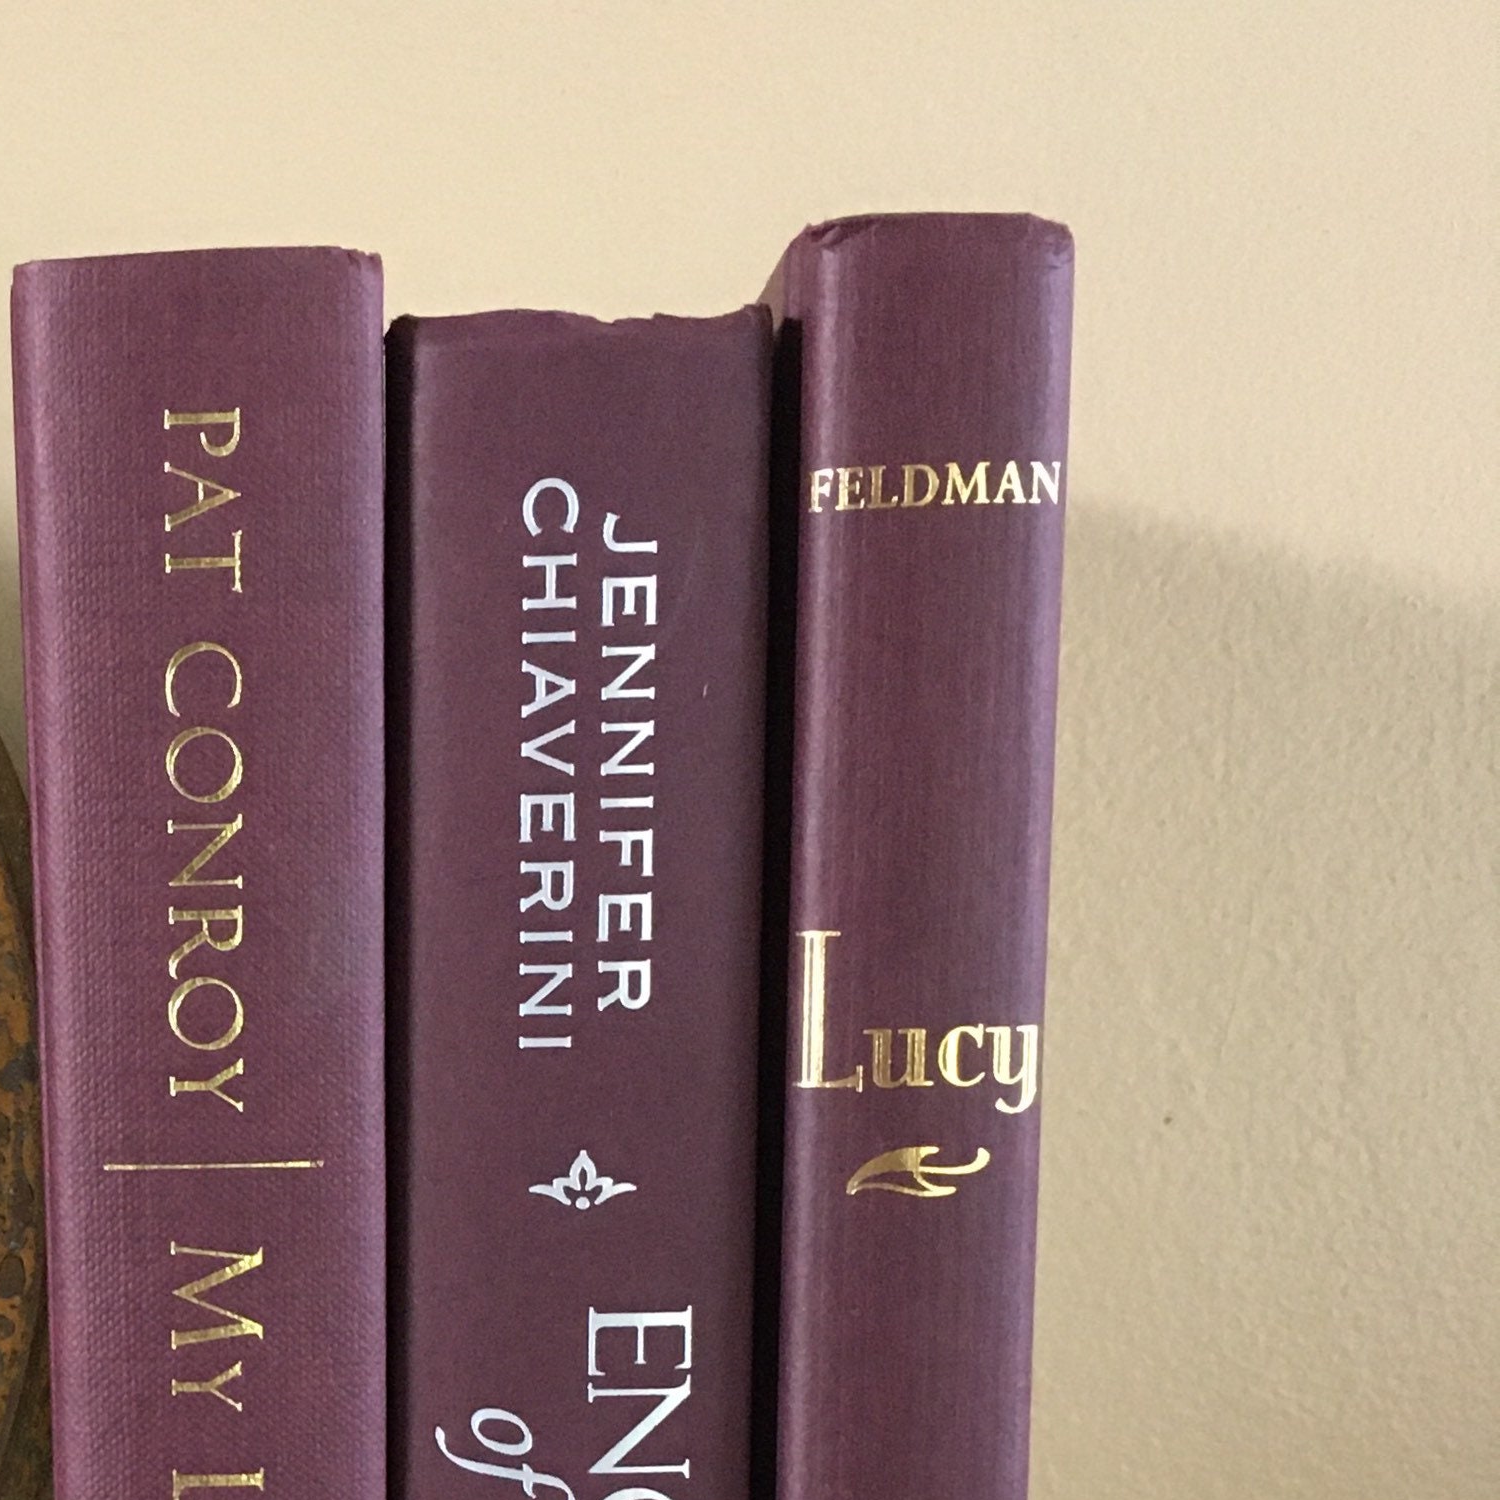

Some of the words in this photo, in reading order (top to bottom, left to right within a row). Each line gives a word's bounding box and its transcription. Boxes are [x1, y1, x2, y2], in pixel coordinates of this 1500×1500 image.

[162, 406, 243, 594] PAT
[808, 462, 1062, 514] FELDMAN
[517, 476, 580, 1051] CHIAVERINI
[595, 512, 659, 1012] JENNIFER
[163, 640, 246, 1113] CONROY
[794, 929, 1040, 1113] Lucy
[169, 1240, 265, 1412] MY
